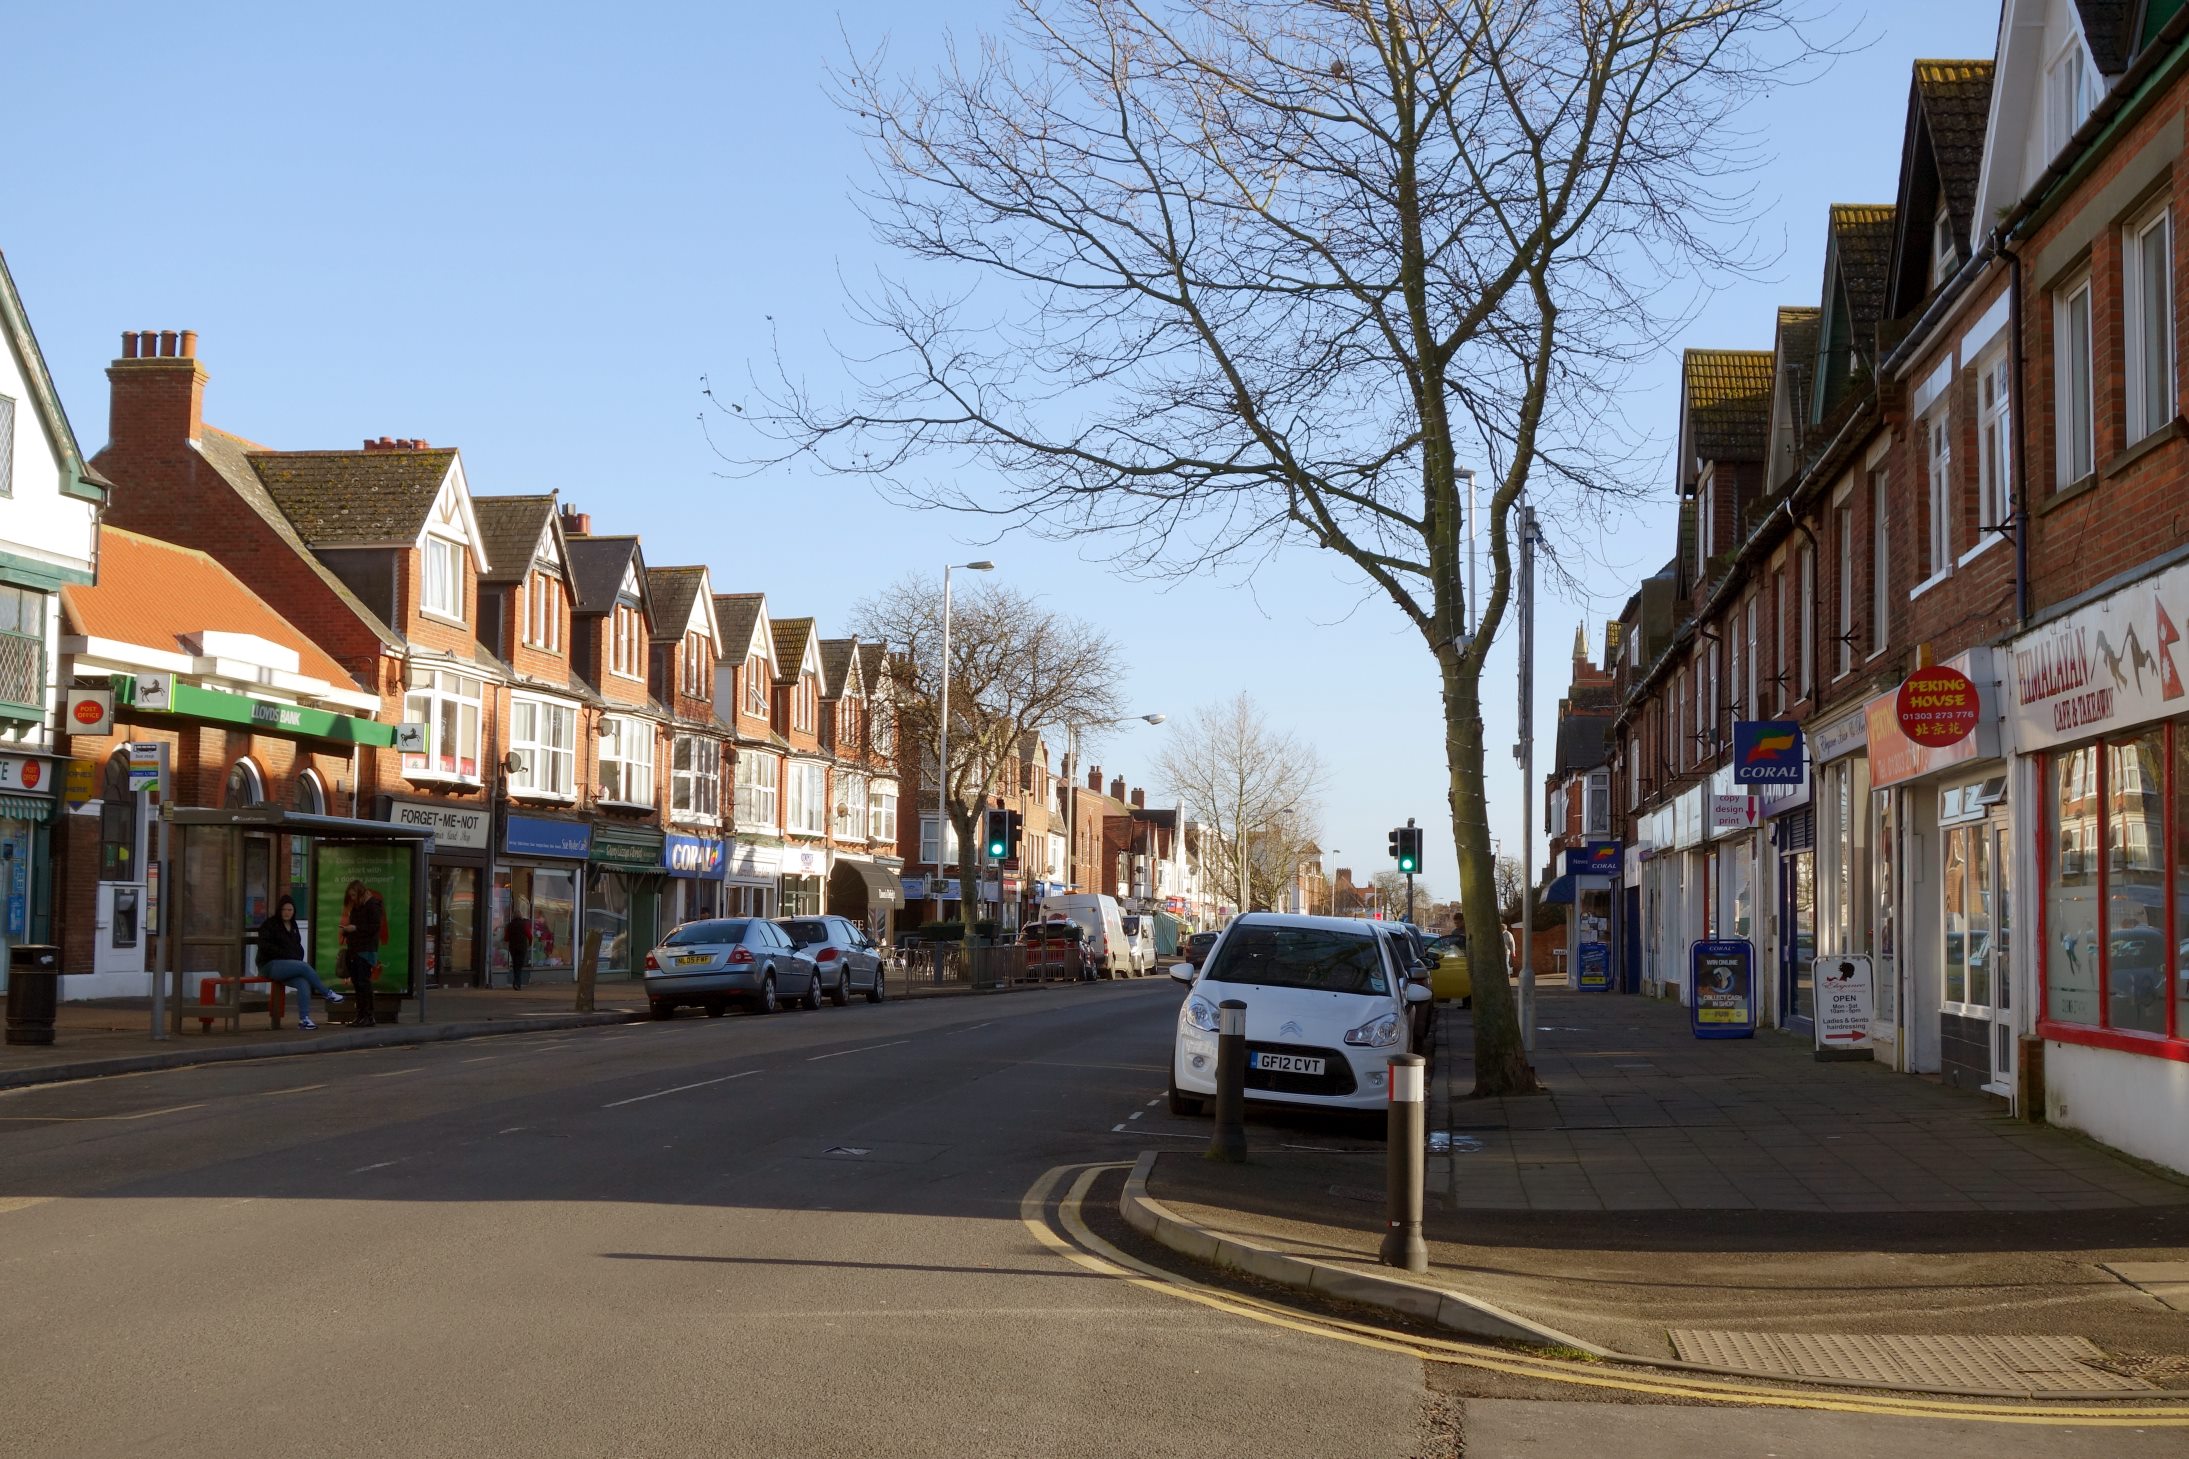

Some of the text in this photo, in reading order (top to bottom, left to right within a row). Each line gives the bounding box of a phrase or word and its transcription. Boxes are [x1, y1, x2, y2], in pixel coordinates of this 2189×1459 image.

[2016, 626, 2088, 706] HIMALAYAN
[1908, 678, 1966, 693] PEKING
[1910, 693, 1966, 708] HOUSE
[2072, 695, 2079, 728] &
[2078, 686, 2114, 725] TAKEAWAY
[251, 704, 301, 726] LLOYDS BANK
[1870, 702, 1899, 743] PEKIN
[1902, 710, 1975, 721] 01303 273 776
[22, 773, 38, 782] OFFICE
[1739, 766, 1799, 778] CORAL
[1719, 795, 1740, 804] copy
[1715, 805, 1744, 815] design
[400, 809, 479, 830] FORGET-ME-NOT
[1719, 818, 1739, 826] print
[672, 843, 713, 873] CORAL
[1832, 995, 1857, 1003] OPEN
[1826, 1023, 1866, 1031] hairdressing
[1261, 1055, 1320, 1072] GF12 CVT
